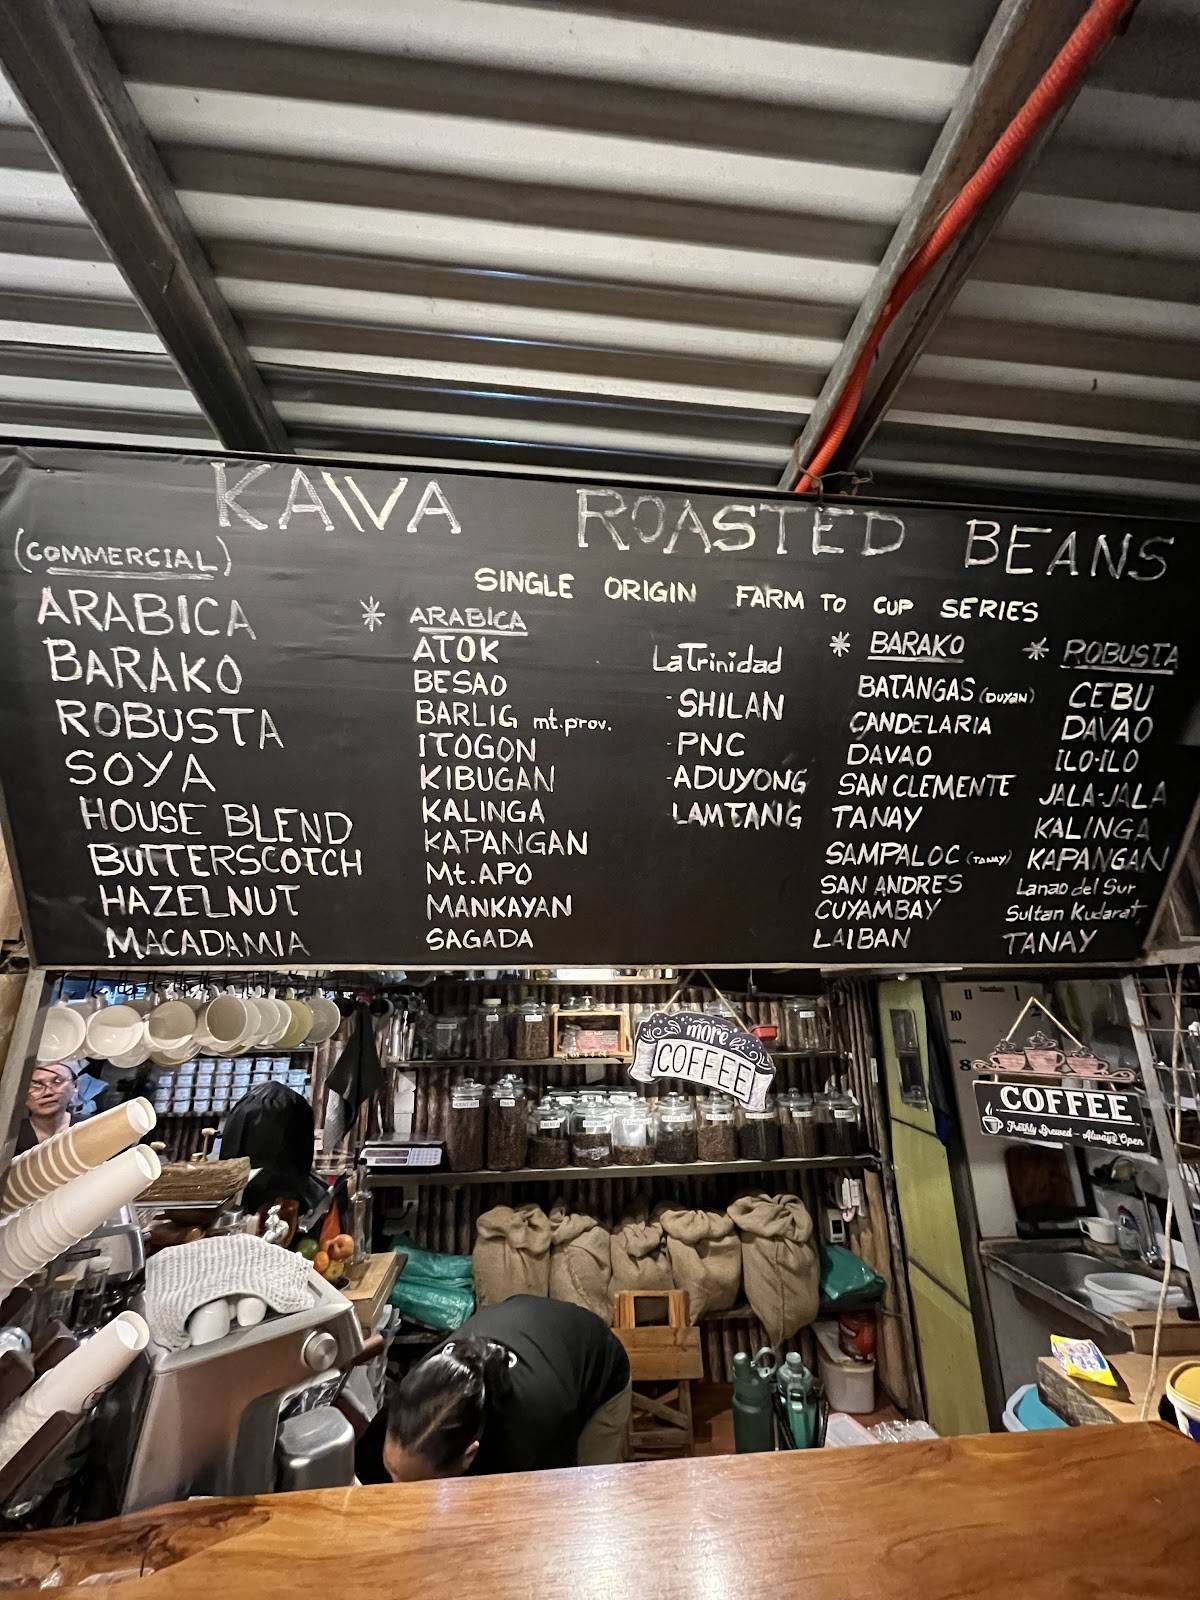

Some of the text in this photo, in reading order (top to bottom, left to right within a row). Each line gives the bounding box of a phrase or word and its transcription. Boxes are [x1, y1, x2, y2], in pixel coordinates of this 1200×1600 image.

[211, 462, 1174, 579] KAWA ROASTED BEANS
[15, 528, 232, 576] (COMMERCIAL)
[474, 568, 1038, 622] SINGLE ORIGIN FARM TO CUP SERIES
[37, 586, 257, 640] ARABICA
[410, 606, 526, 631] ARABICA
[412, 635, 499, 663] ATOK
[869, 631, 965, 658] BARAKO
[1063, 639, 1179, 667] ROBUSTA
[42, 637, 242, 694] BARAKO
[414, 670, 507, 696] BESAO
[858, 674, 975, 702] BATANGAS
[1069, 682, 1154, 711] CEBU
[56, 699, 284, 750] ROBUSTA
[417, 700, 517, 728] BARLIG
[850, 711, 991, 740] CANDELARIA
[1061, 715, 1153, 743] DAVAO
[419, 732, 535, 763] ITOGON
[847, 744, 931, 766] DAVAO
[66, 750, 216, 792] SOYA
[421, 764, 554, 792] KIBUGAN
[838, 773, 1016, 800] SAN CLEMENTE
[1038, 781, 1167, 809] JALA-JALA
[80, 796, 353, 845] HOUSE BLEND
[423, 796, 544, 824] KALINGA
[673, 801, 802, 830] LAMTANG
[832, 805, 923, 832] TANAY
[425, 829, 587, 855] KAPANGAN
[1034, 816, 1150, 840] KALINGA
[87, 842, 362, 877] BUTTERSCOTCH
[825, 841, 959, 866] SAMPALOC
[1027, 847, 1169, 871] KAPANGAN
[821, 874, 962, 896] SAN ANDRES
[1017, 878, 1136, 896] Lanao del Sur
[99, 885, 300, 918] HAZELNUT
[427, 894, 571, 920] MANKAYAN
[815, 898, 941, 920] CUYAMBAY
[1006, 905, 1064, 922] Sultan
[106, 927, 309, 959] MACADAMIA
[426, 928, 533, 950] SAGADA
[813, 927, 910, 949] LAIBAN
[1002, 929, 1097, 954] TANAY
[686, 1022, 730, 1046] more
[657, 1043, 752, 1096] COFFEE
[999, 1086, 1132, 1122] COFFEE
[1006, 1119, 1038, 1137] Freshly
[1038, 1123, 1073, 1138] Brewed
[1082, 1129, 1120, 1146] Always
[1118, 1132, 1145, 1147] Open
